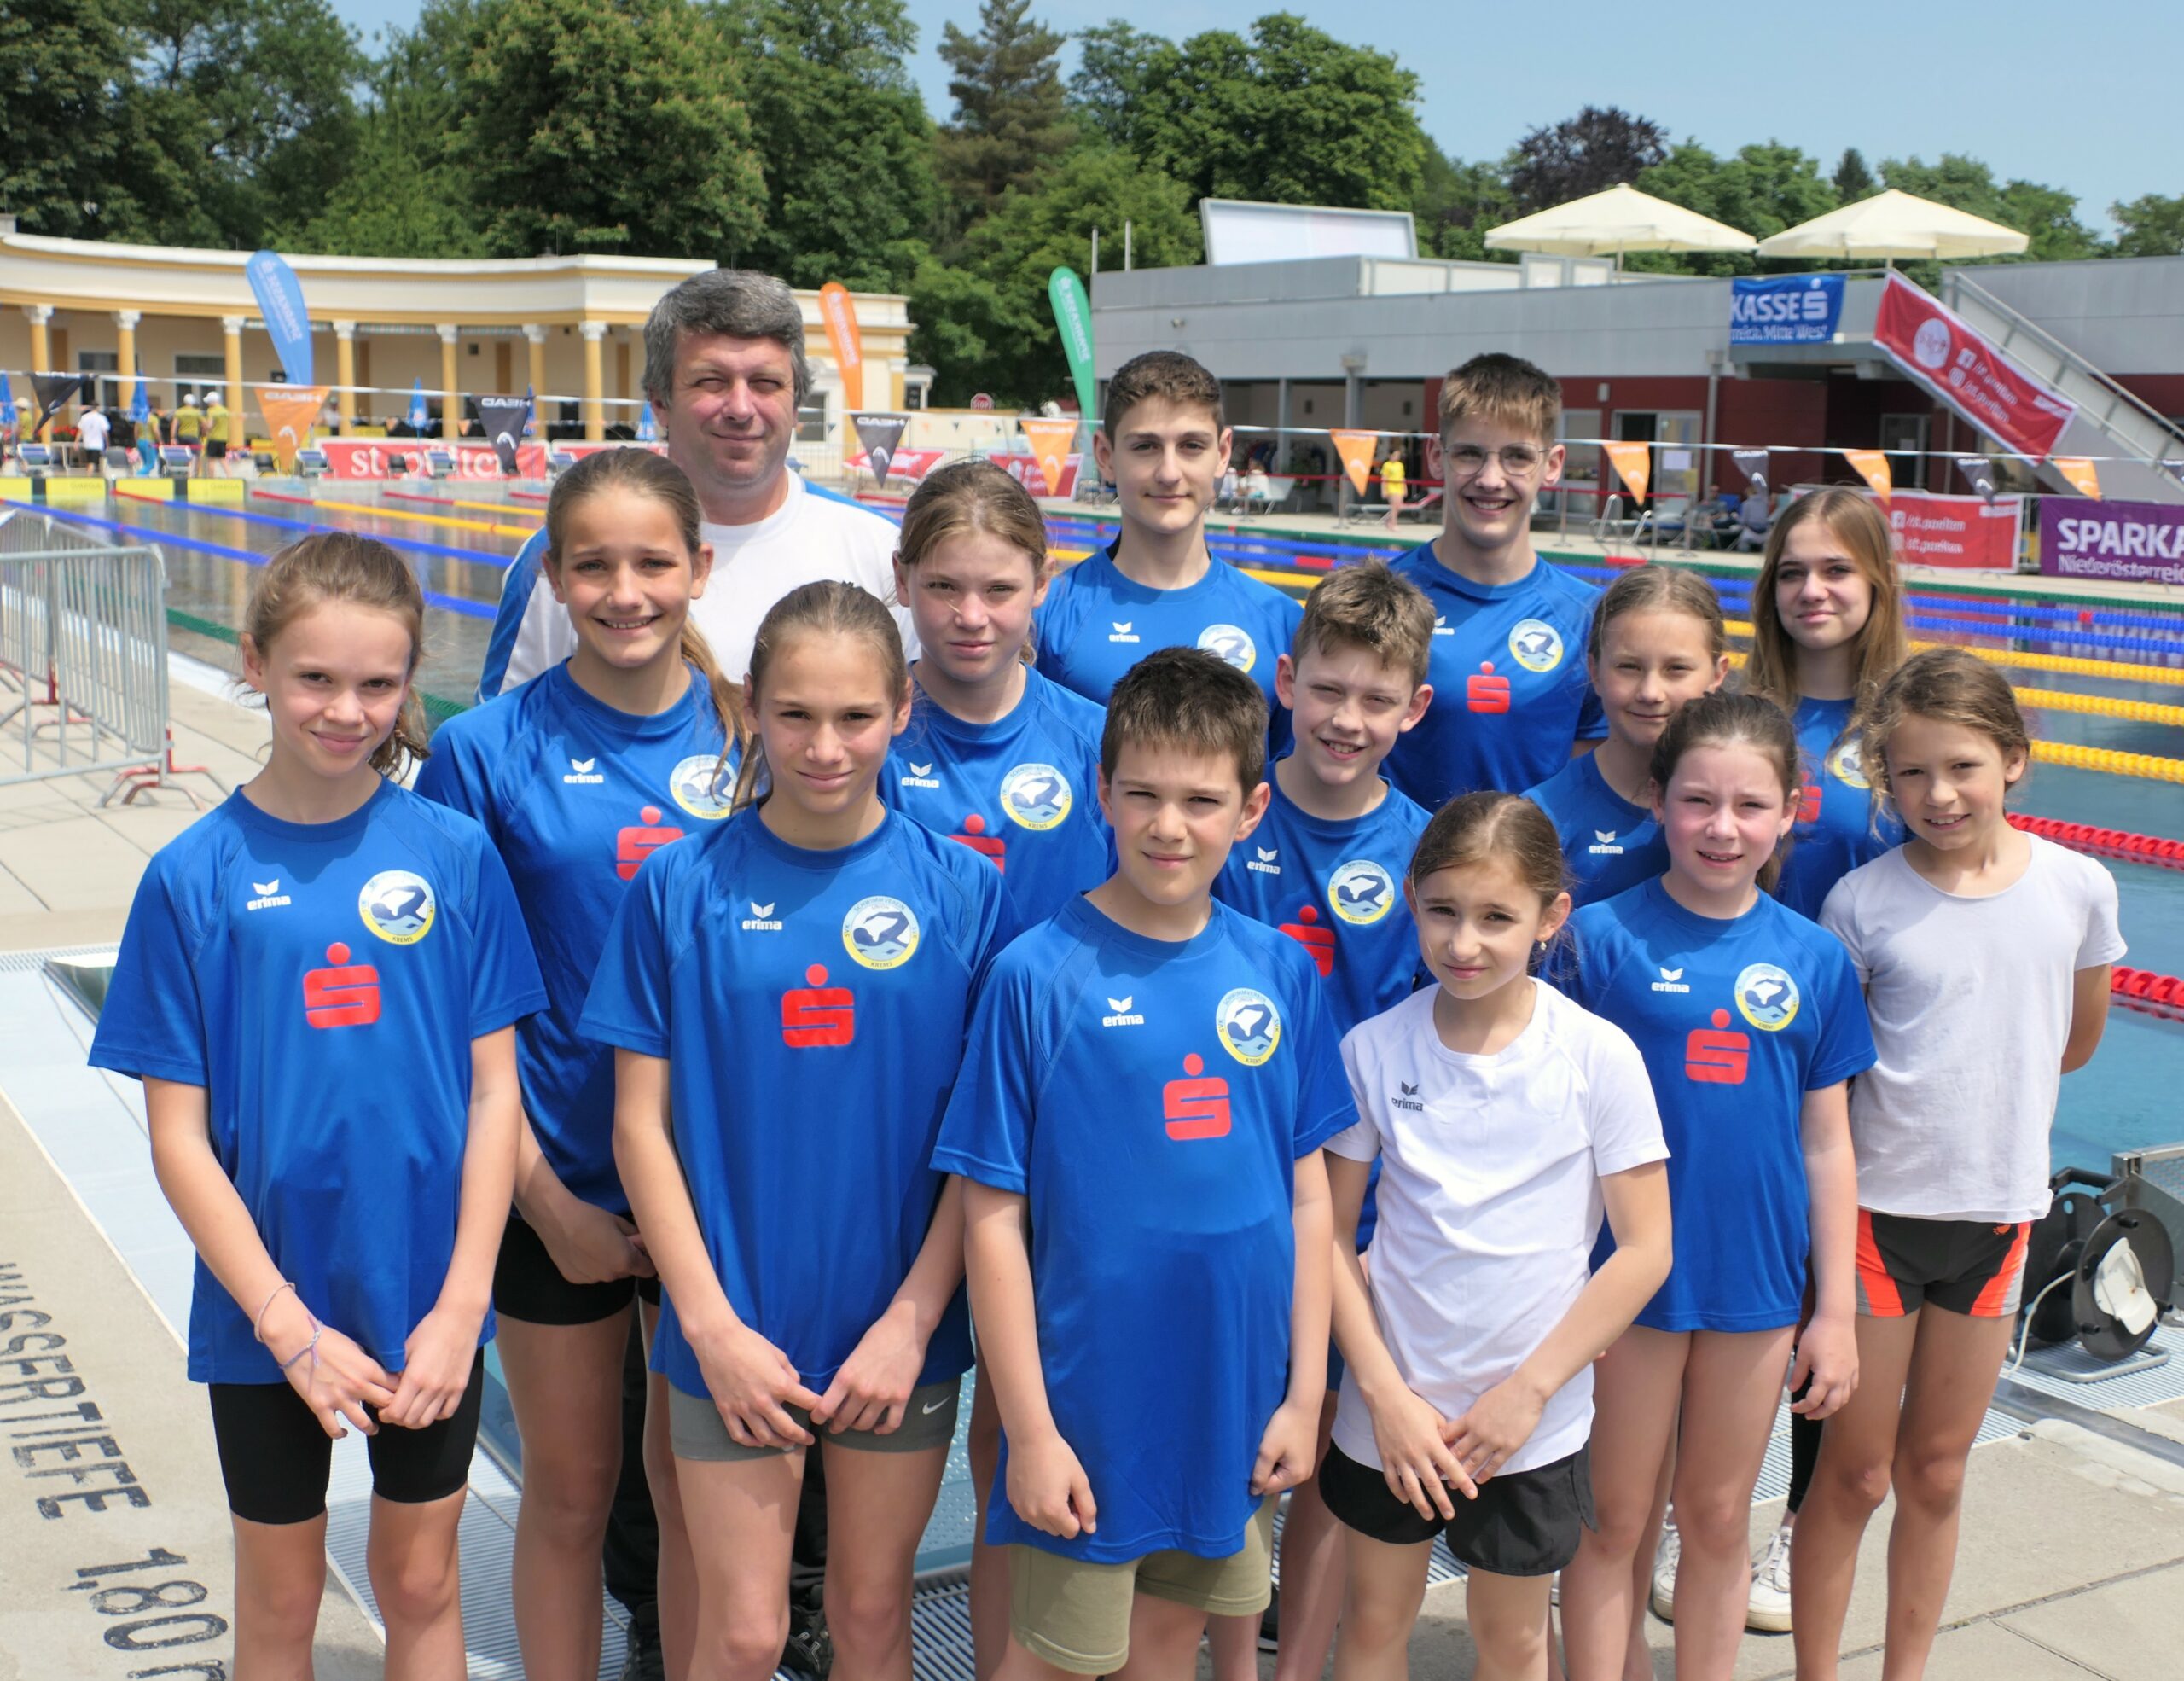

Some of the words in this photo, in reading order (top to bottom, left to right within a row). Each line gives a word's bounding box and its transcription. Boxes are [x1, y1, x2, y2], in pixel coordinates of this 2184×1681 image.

[1730, 292, 1802, 322] KASSE
[2057, 518, 2184, 559] SPARKA
[1108, 633, 1141, 643] erima
[563, 773, 604, 784] erima
[901, 776, 940, 788] erima
[1589, 844, 1624, 854] erima
[1246, 860, 1281, 875] erima
[247, 895, 292, 911] erima
[741, 918, 783, 930] erima
[1651, 981, 1690, 993] erima
[1102, 1013, 1145, 1027] erima
[1391, 1097, 1424, 1112] erima
